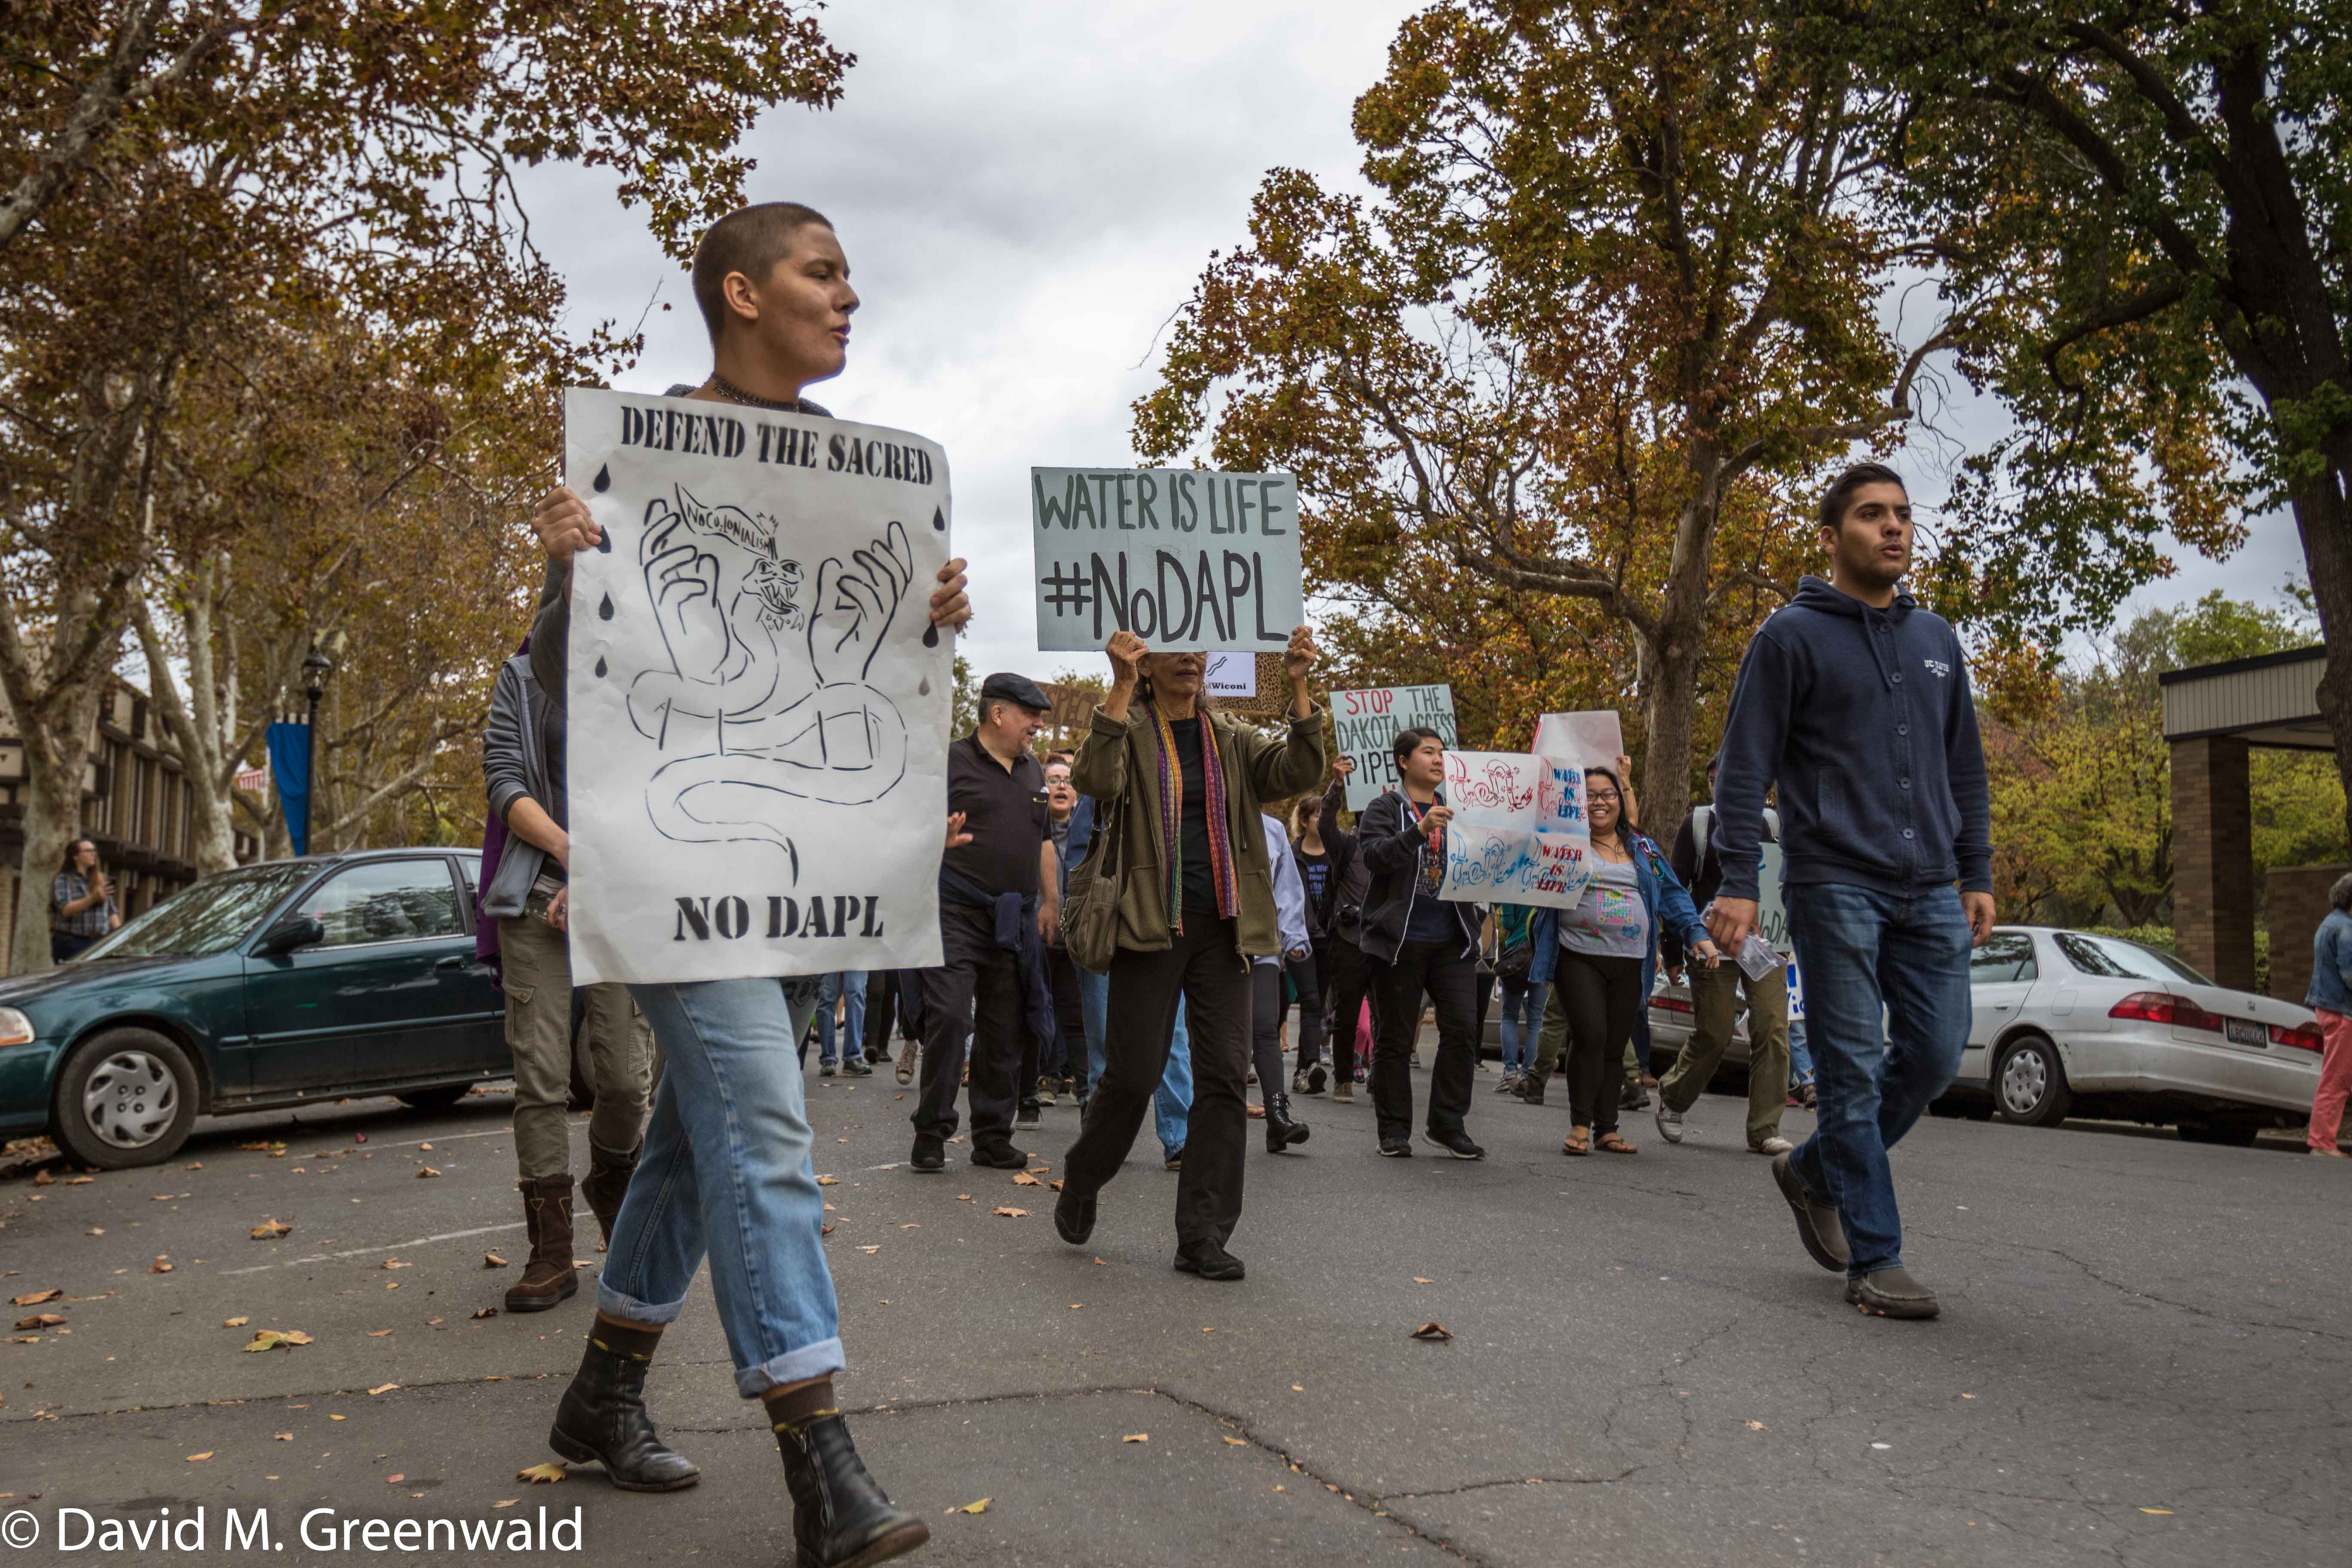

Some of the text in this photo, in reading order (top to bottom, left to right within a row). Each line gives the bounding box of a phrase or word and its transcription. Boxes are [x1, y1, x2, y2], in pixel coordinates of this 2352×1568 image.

[620, 405, 934, 486] DEFEND THE SACRED
[1035, 473, 1286, 536] WATER IS LIFE
[1344, 686, 1445, 715] STOP THE
[1336, 714, 1401, 752] DAKOTA
[673, 895, 884, 941] NO DAPL
